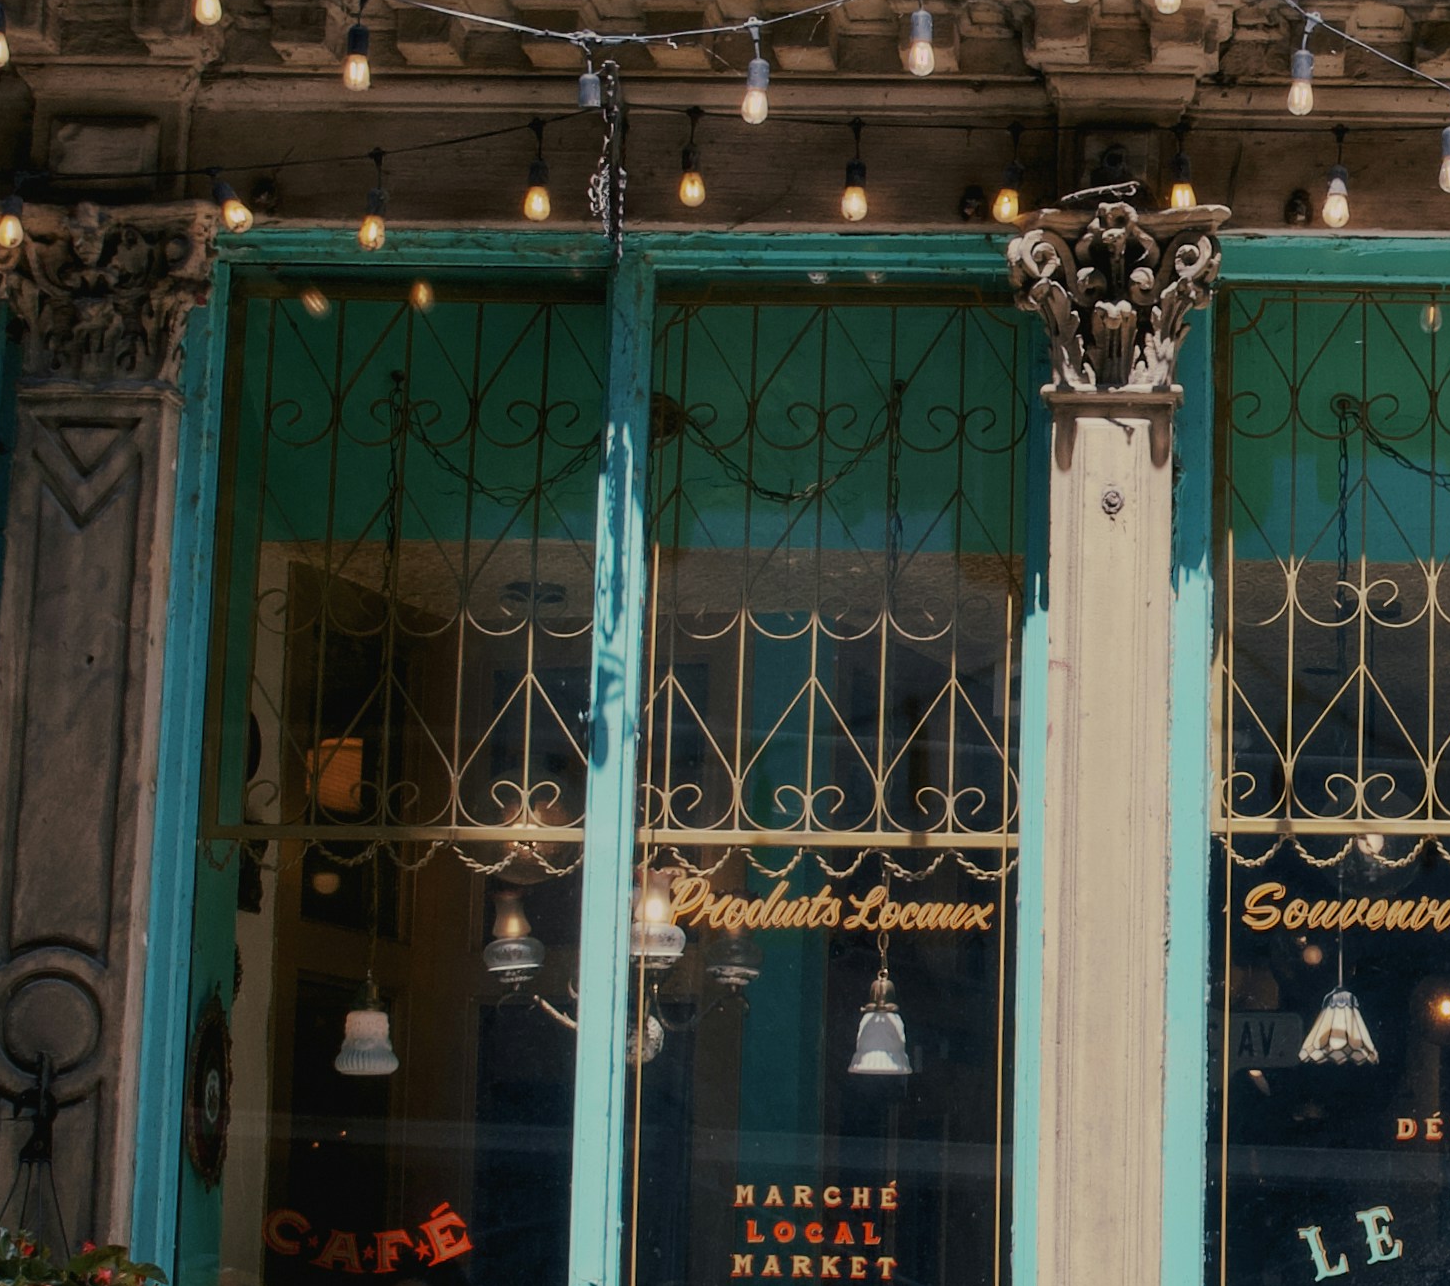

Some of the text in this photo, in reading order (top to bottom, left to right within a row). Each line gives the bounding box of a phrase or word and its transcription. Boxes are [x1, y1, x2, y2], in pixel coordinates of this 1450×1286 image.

[669, 876, 994, 932] Produits Locaux
[734, 1180, 900, 1210] MARCHÉ
[261, 1202, 474, 1274] CAFÉ
[745, 1219, 884, 1246] LOCAL
[1298, 1206, 1403, 1283] LE
[731, 1252, 899, 1281] MARKET
